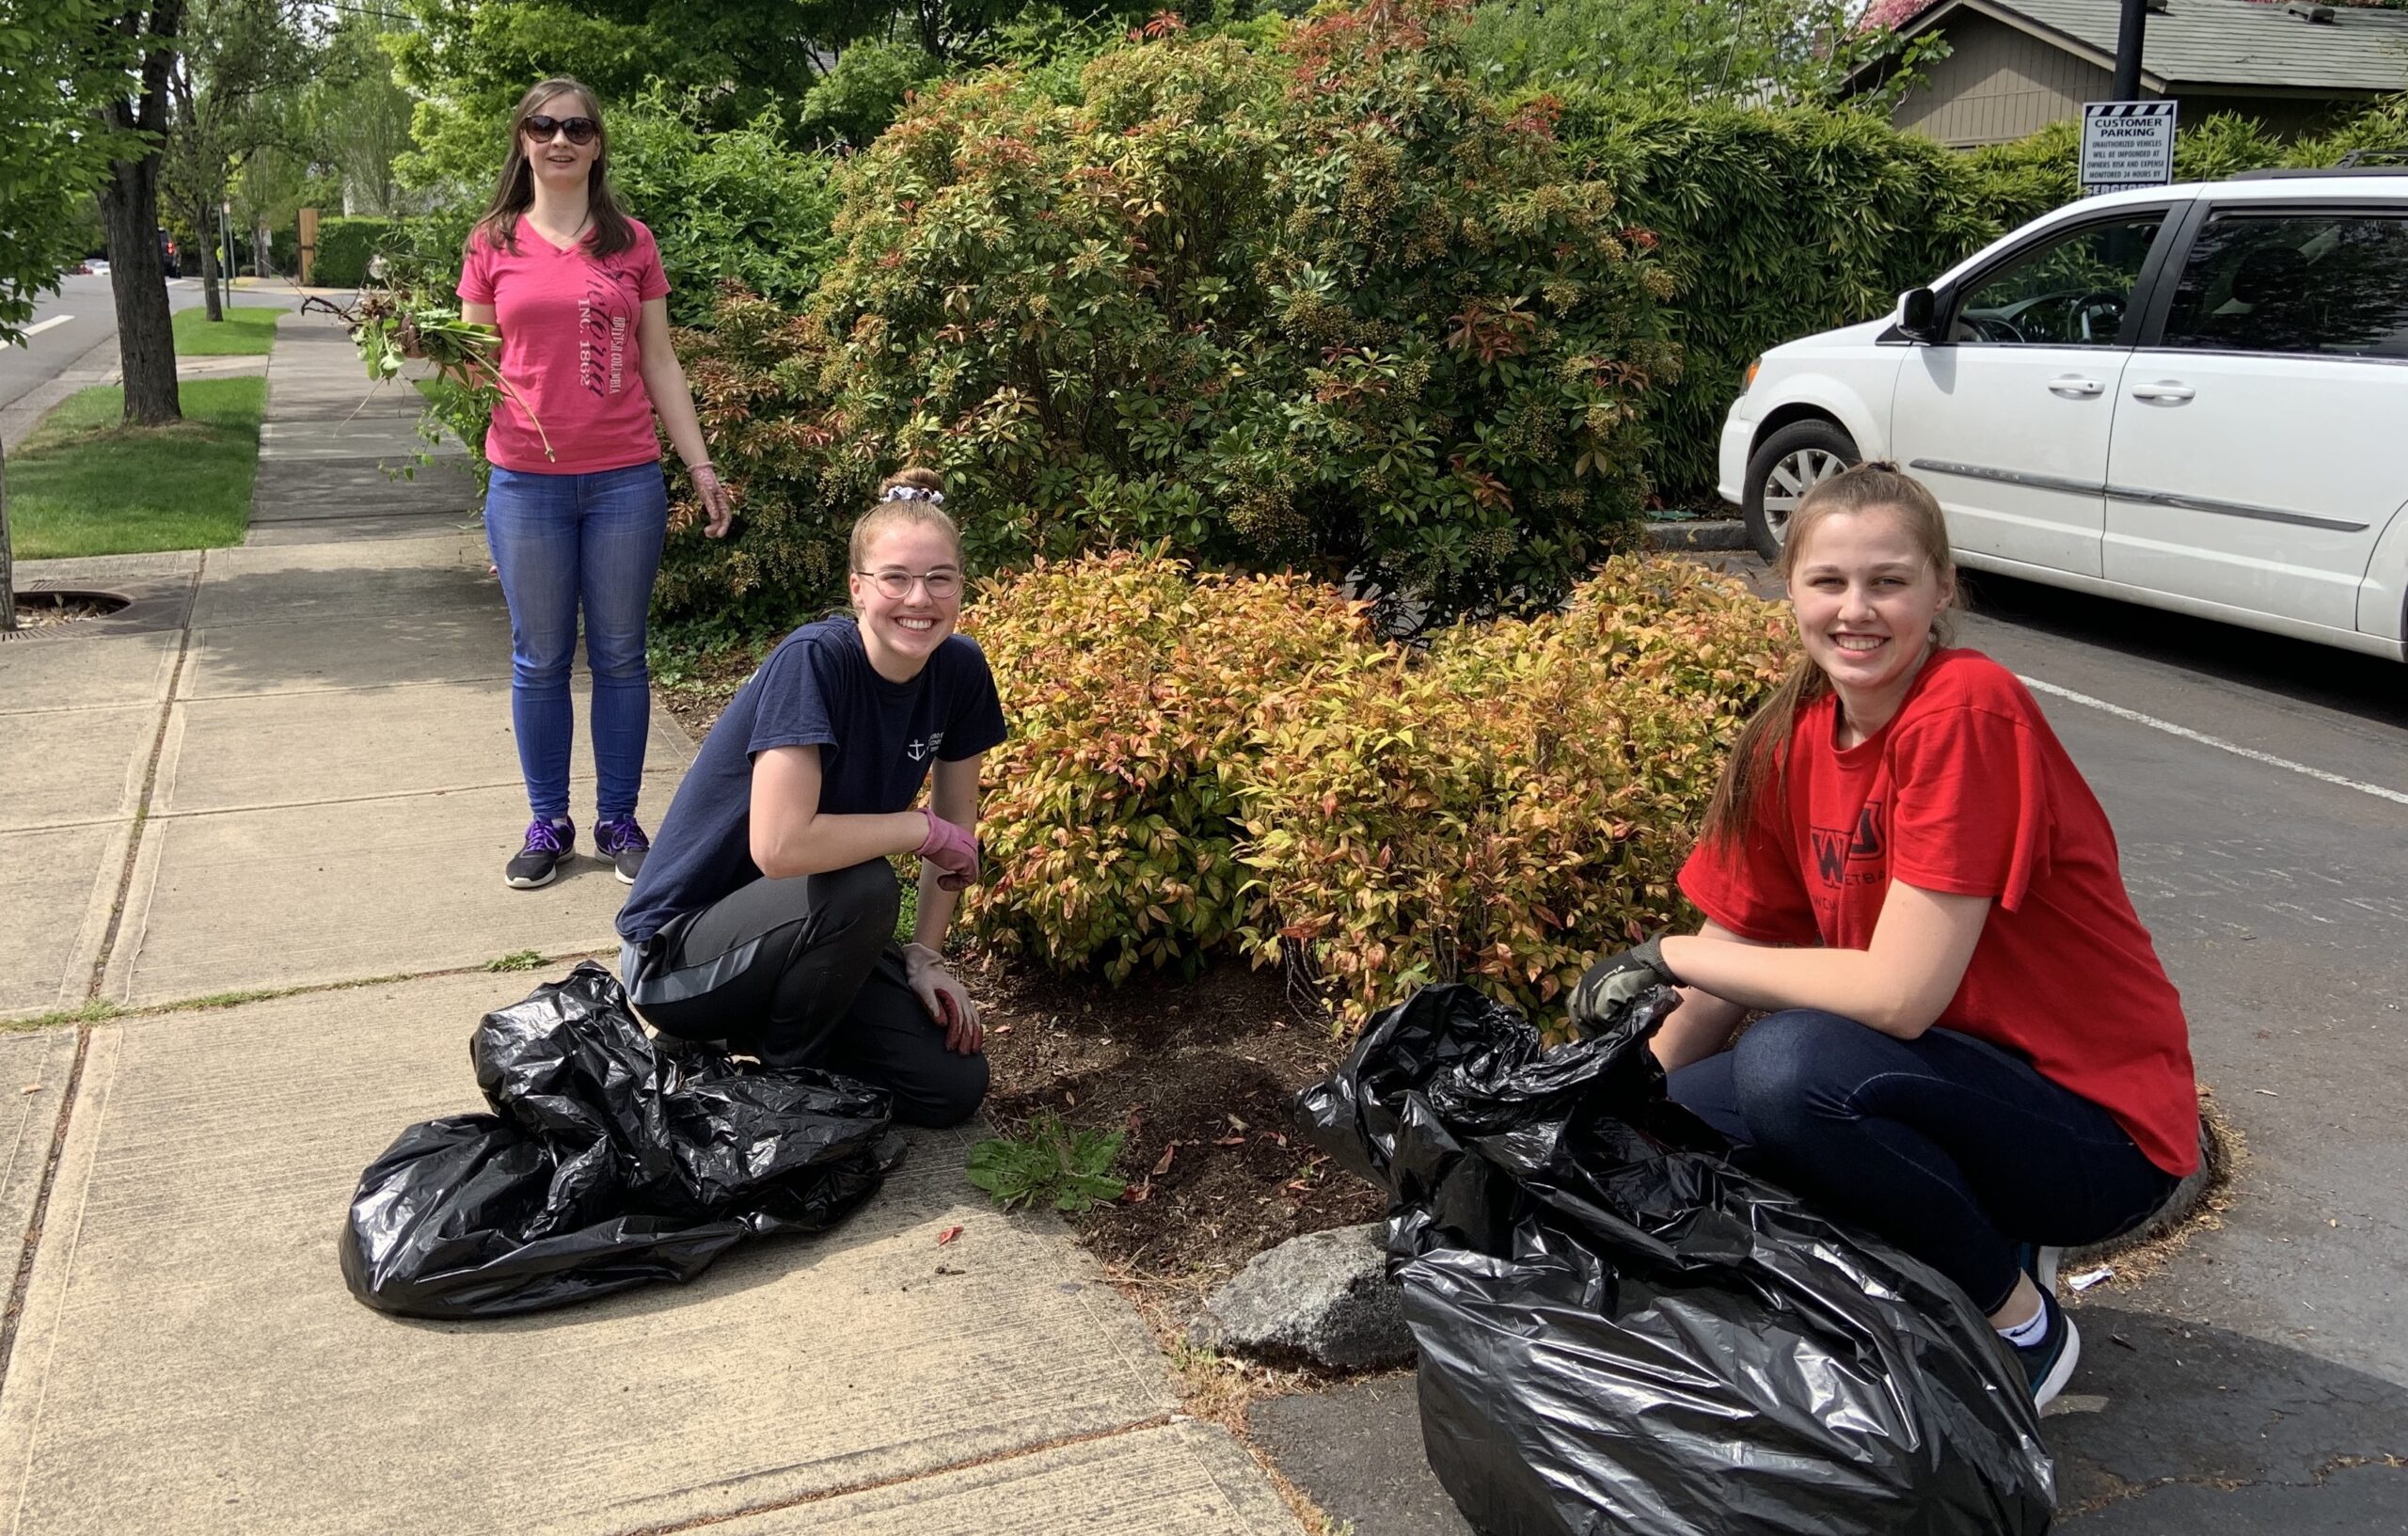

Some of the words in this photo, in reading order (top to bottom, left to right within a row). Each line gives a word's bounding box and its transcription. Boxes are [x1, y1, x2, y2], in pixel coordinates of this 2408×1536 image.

[2095, 119, 2162, 127] CUSTOMER
[2100, 128, 2154, 136] PARKING
[578, 298, 591, 334] INC.
[578, 339, 591, 387] 1862
